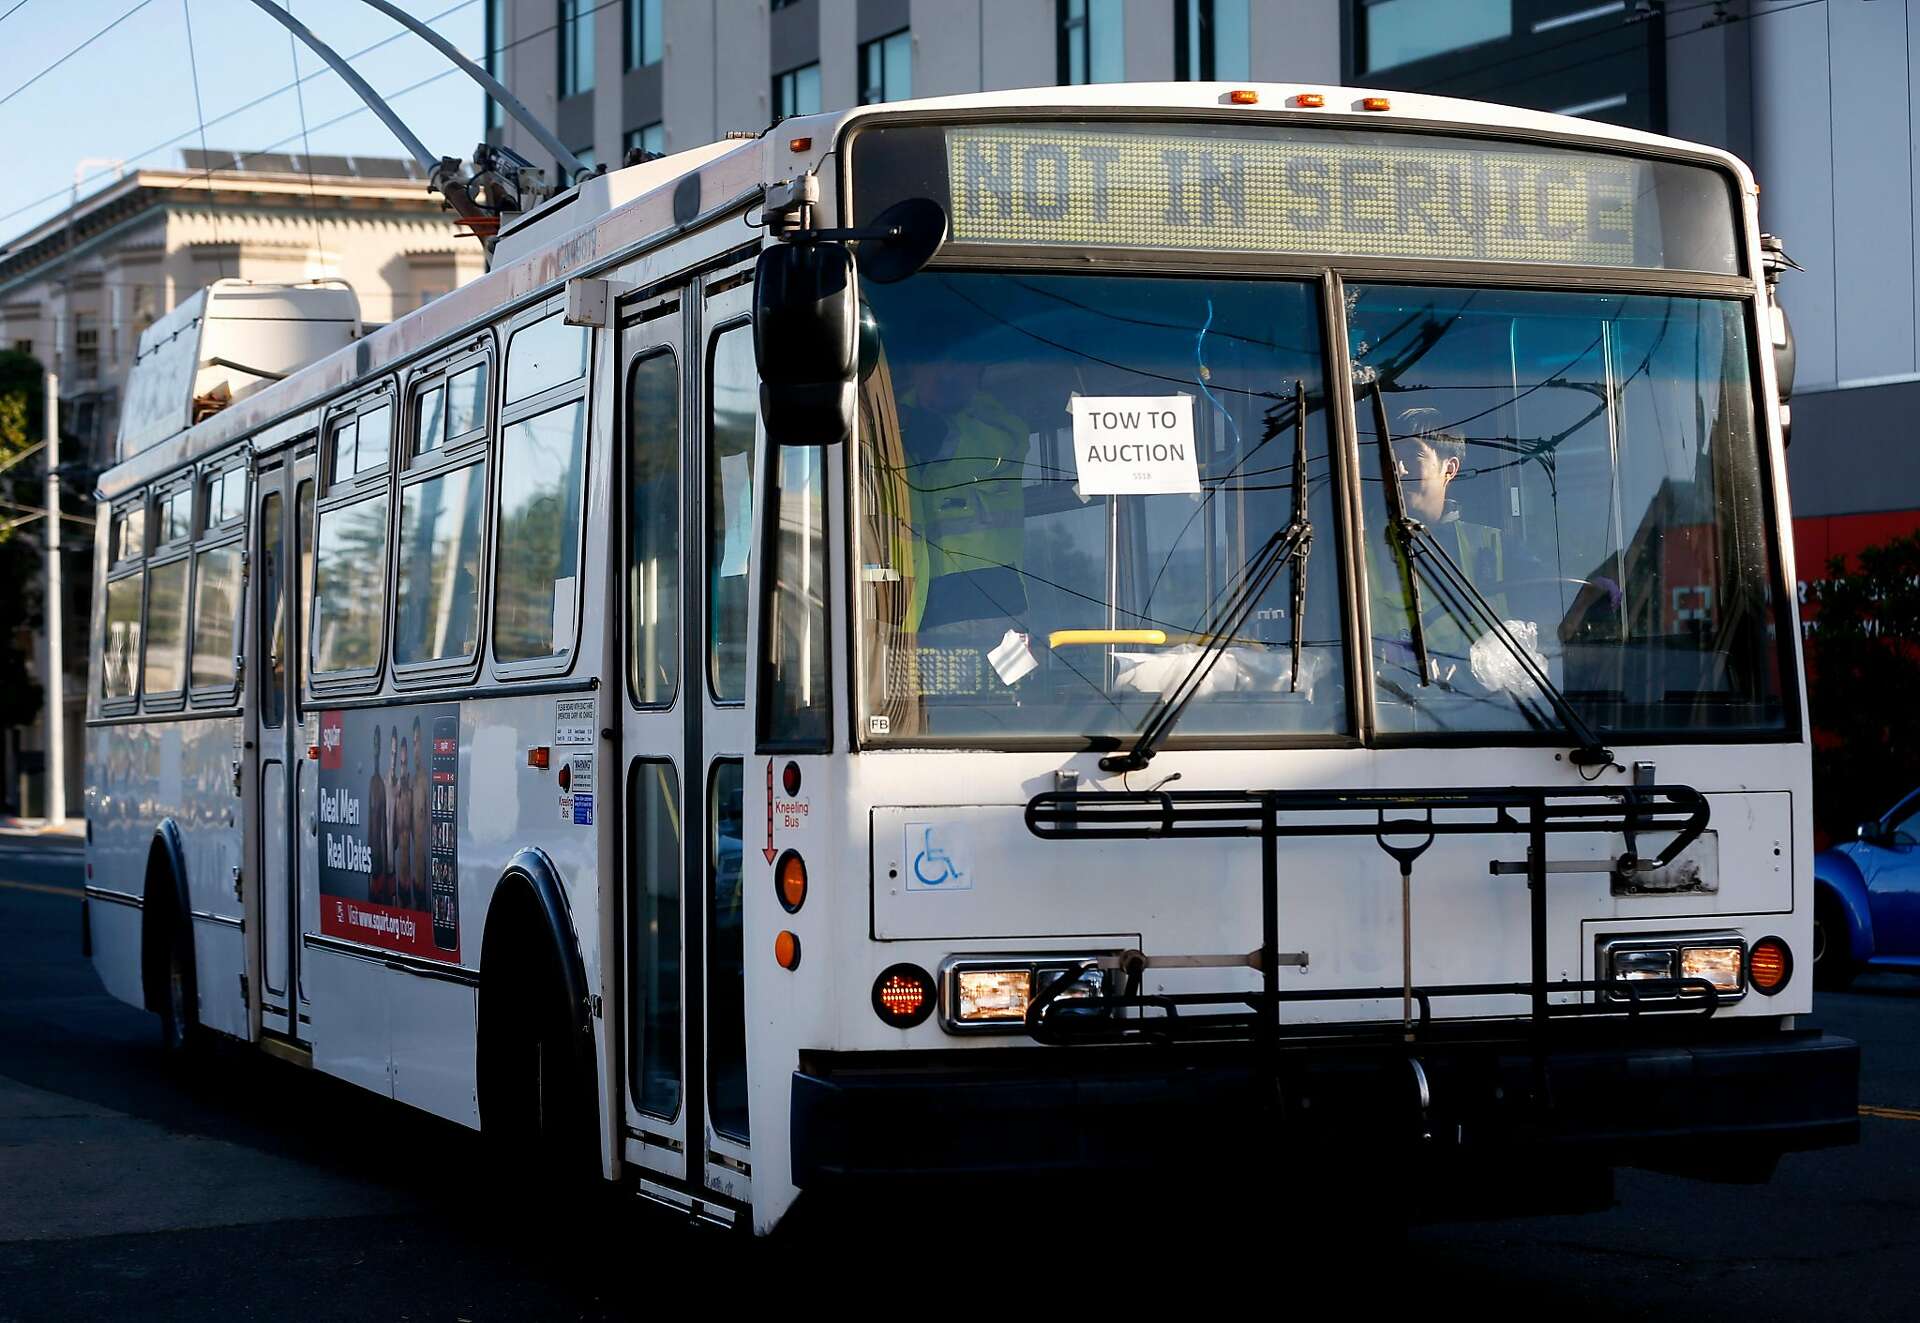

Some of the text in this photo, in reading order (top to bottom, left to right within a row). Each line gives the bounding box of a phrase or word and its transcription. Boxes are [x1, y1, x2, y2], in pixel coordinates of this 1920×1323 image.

[965, 140, 1632, 257] NOT IN SERVICE
[1087, 410, 1177, 430] TOW TO
[1087, 443, 1185, 463] AUCTION
[872, 719, 888, 729] FB
[320, 787, 360, 825] Real Men
[775, 801, 808, 816] Kneeling
[784, 815, 800, 827] Bus
[327, 832, 372, 874] Real Dates
[347, 904, 359, 926] Visit
[399, 914, 416, 943] today
